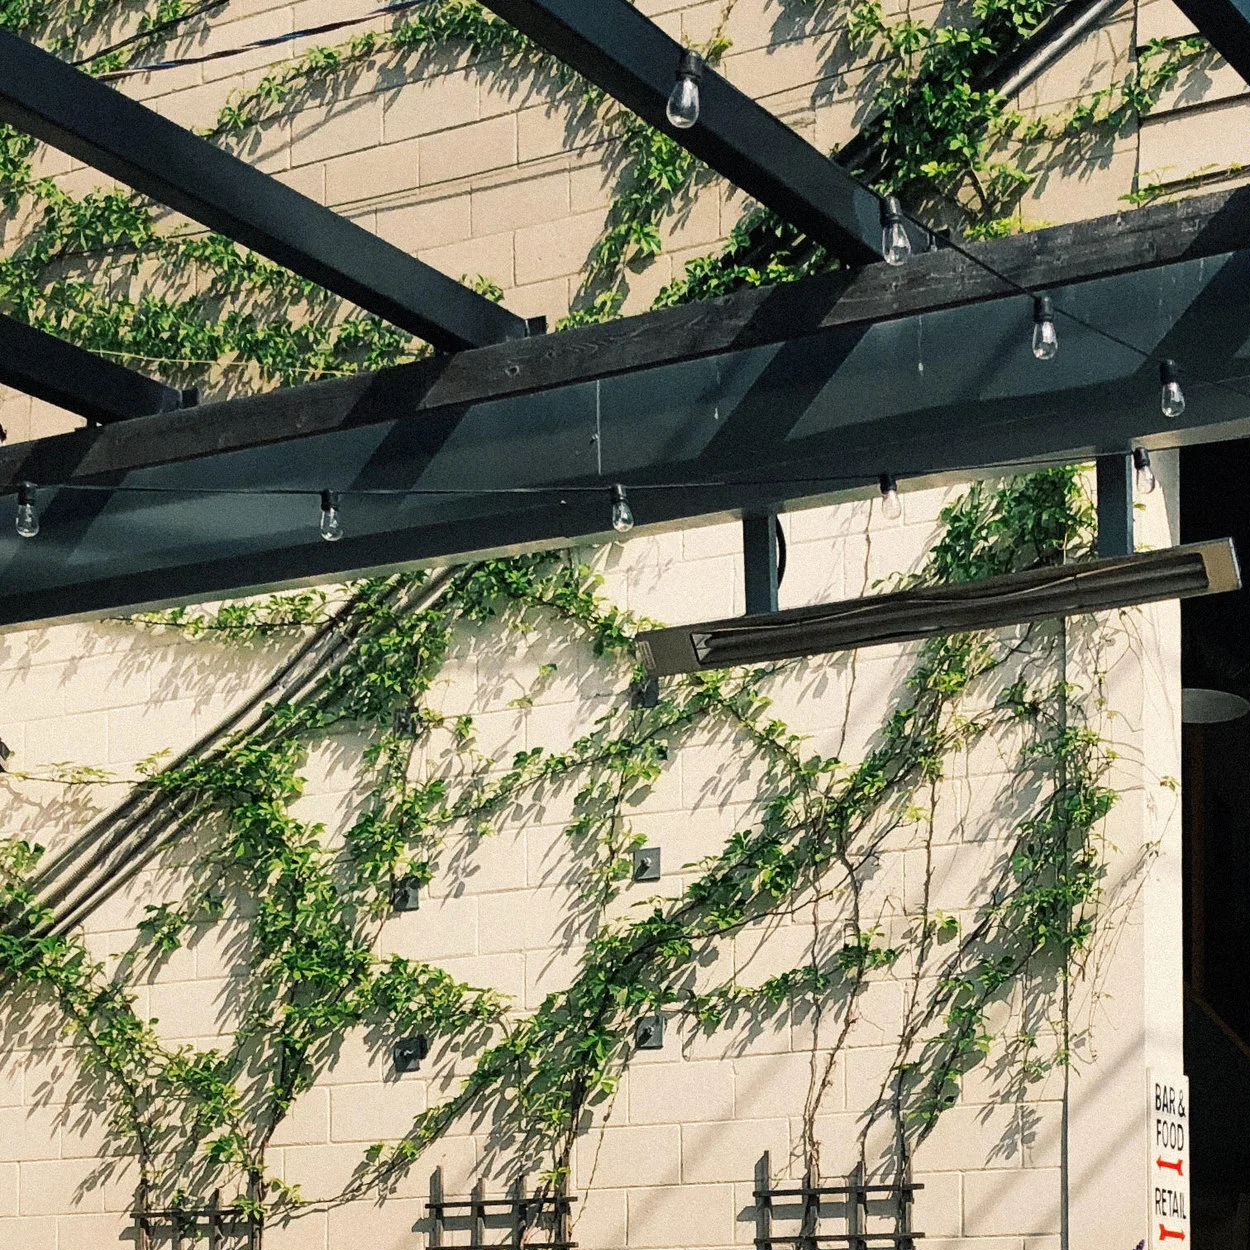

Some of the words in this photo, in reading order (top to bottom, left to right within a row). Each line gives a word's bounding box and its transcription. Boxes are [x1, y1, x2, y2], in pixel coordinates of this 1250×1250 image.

[1155, 1083, 1175, 1115] BAR
[1177, 1089, 1186, 1118] &
[1156, 1119, 1184, 1151] FOOD
[1155, 1187, 1187, 1220] RETAIL
